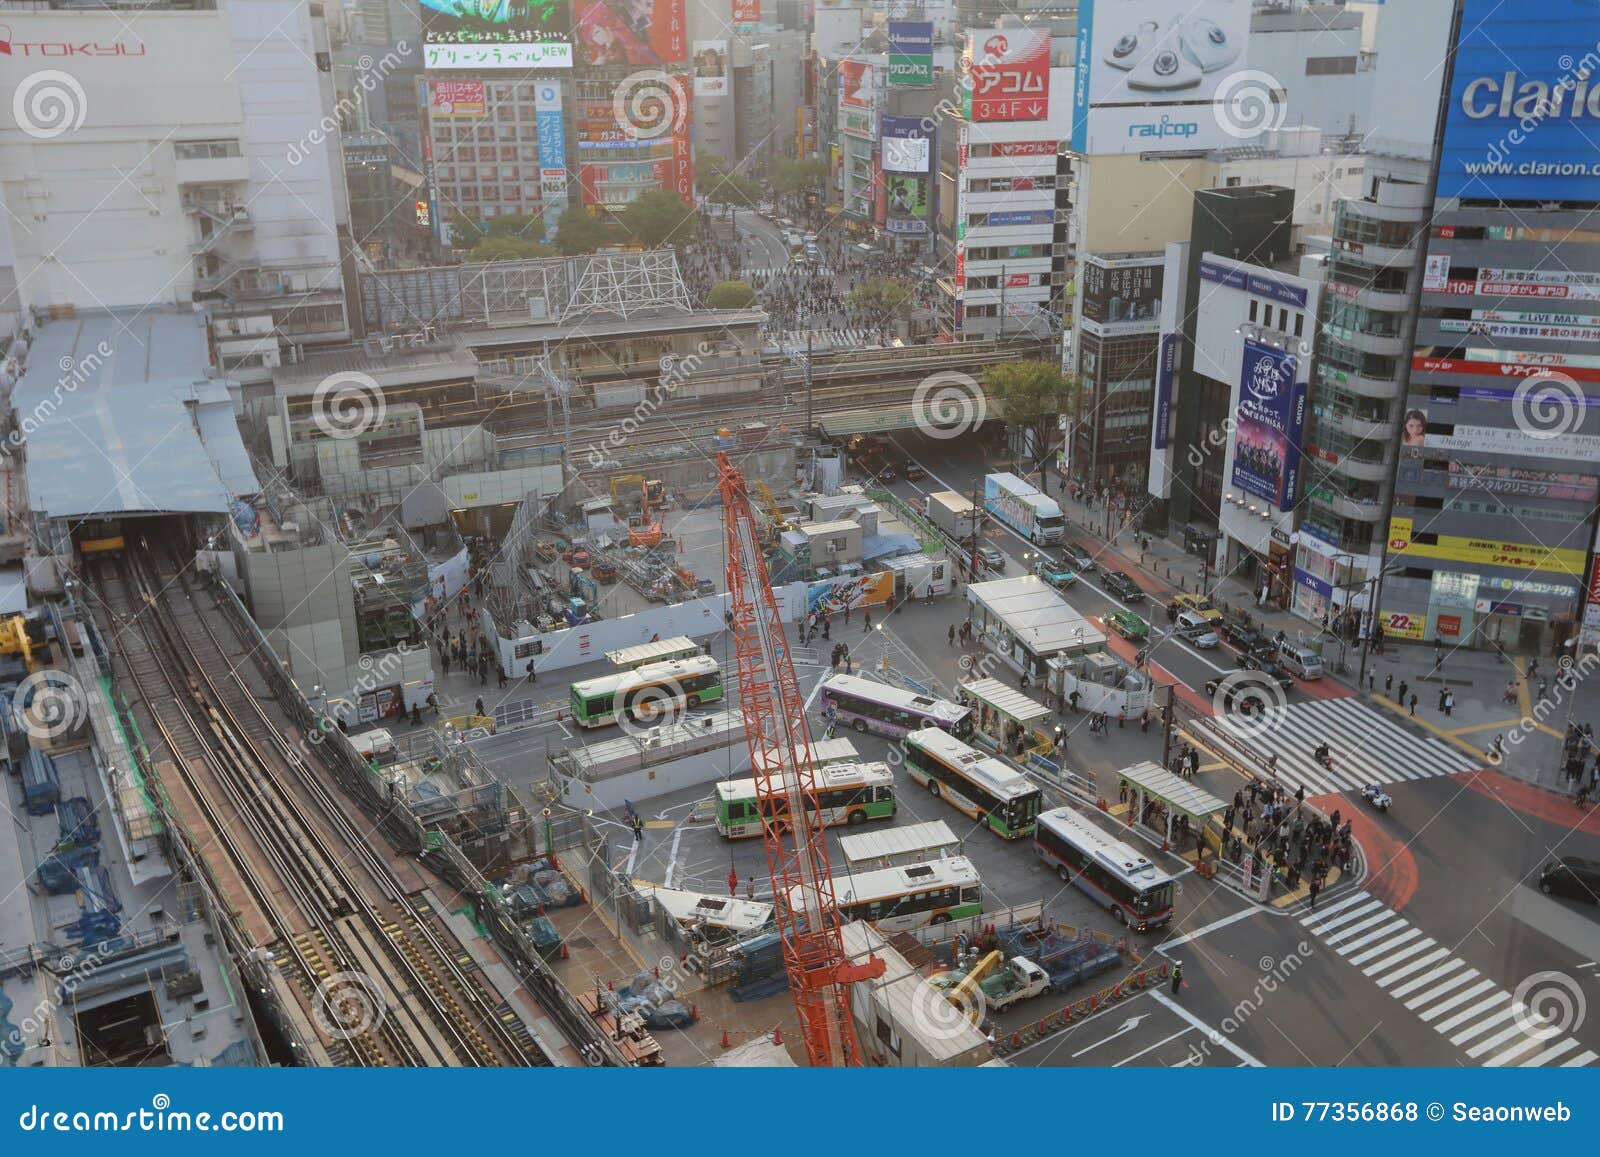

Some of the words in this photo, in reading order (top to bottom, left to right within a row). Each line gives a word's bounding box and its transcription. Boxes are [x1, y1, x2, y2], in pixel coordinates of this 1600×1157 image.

[12, 42, 146, 57] TOKYU
[429, 47, 542, 65] グリーンラベル
[543, 47, 568, 57] NEW
[980, 71, 1044, 94] アコム
[1129, 115, 1198, 139] raycop
[1513, 365, 1552, 377] アイフル
